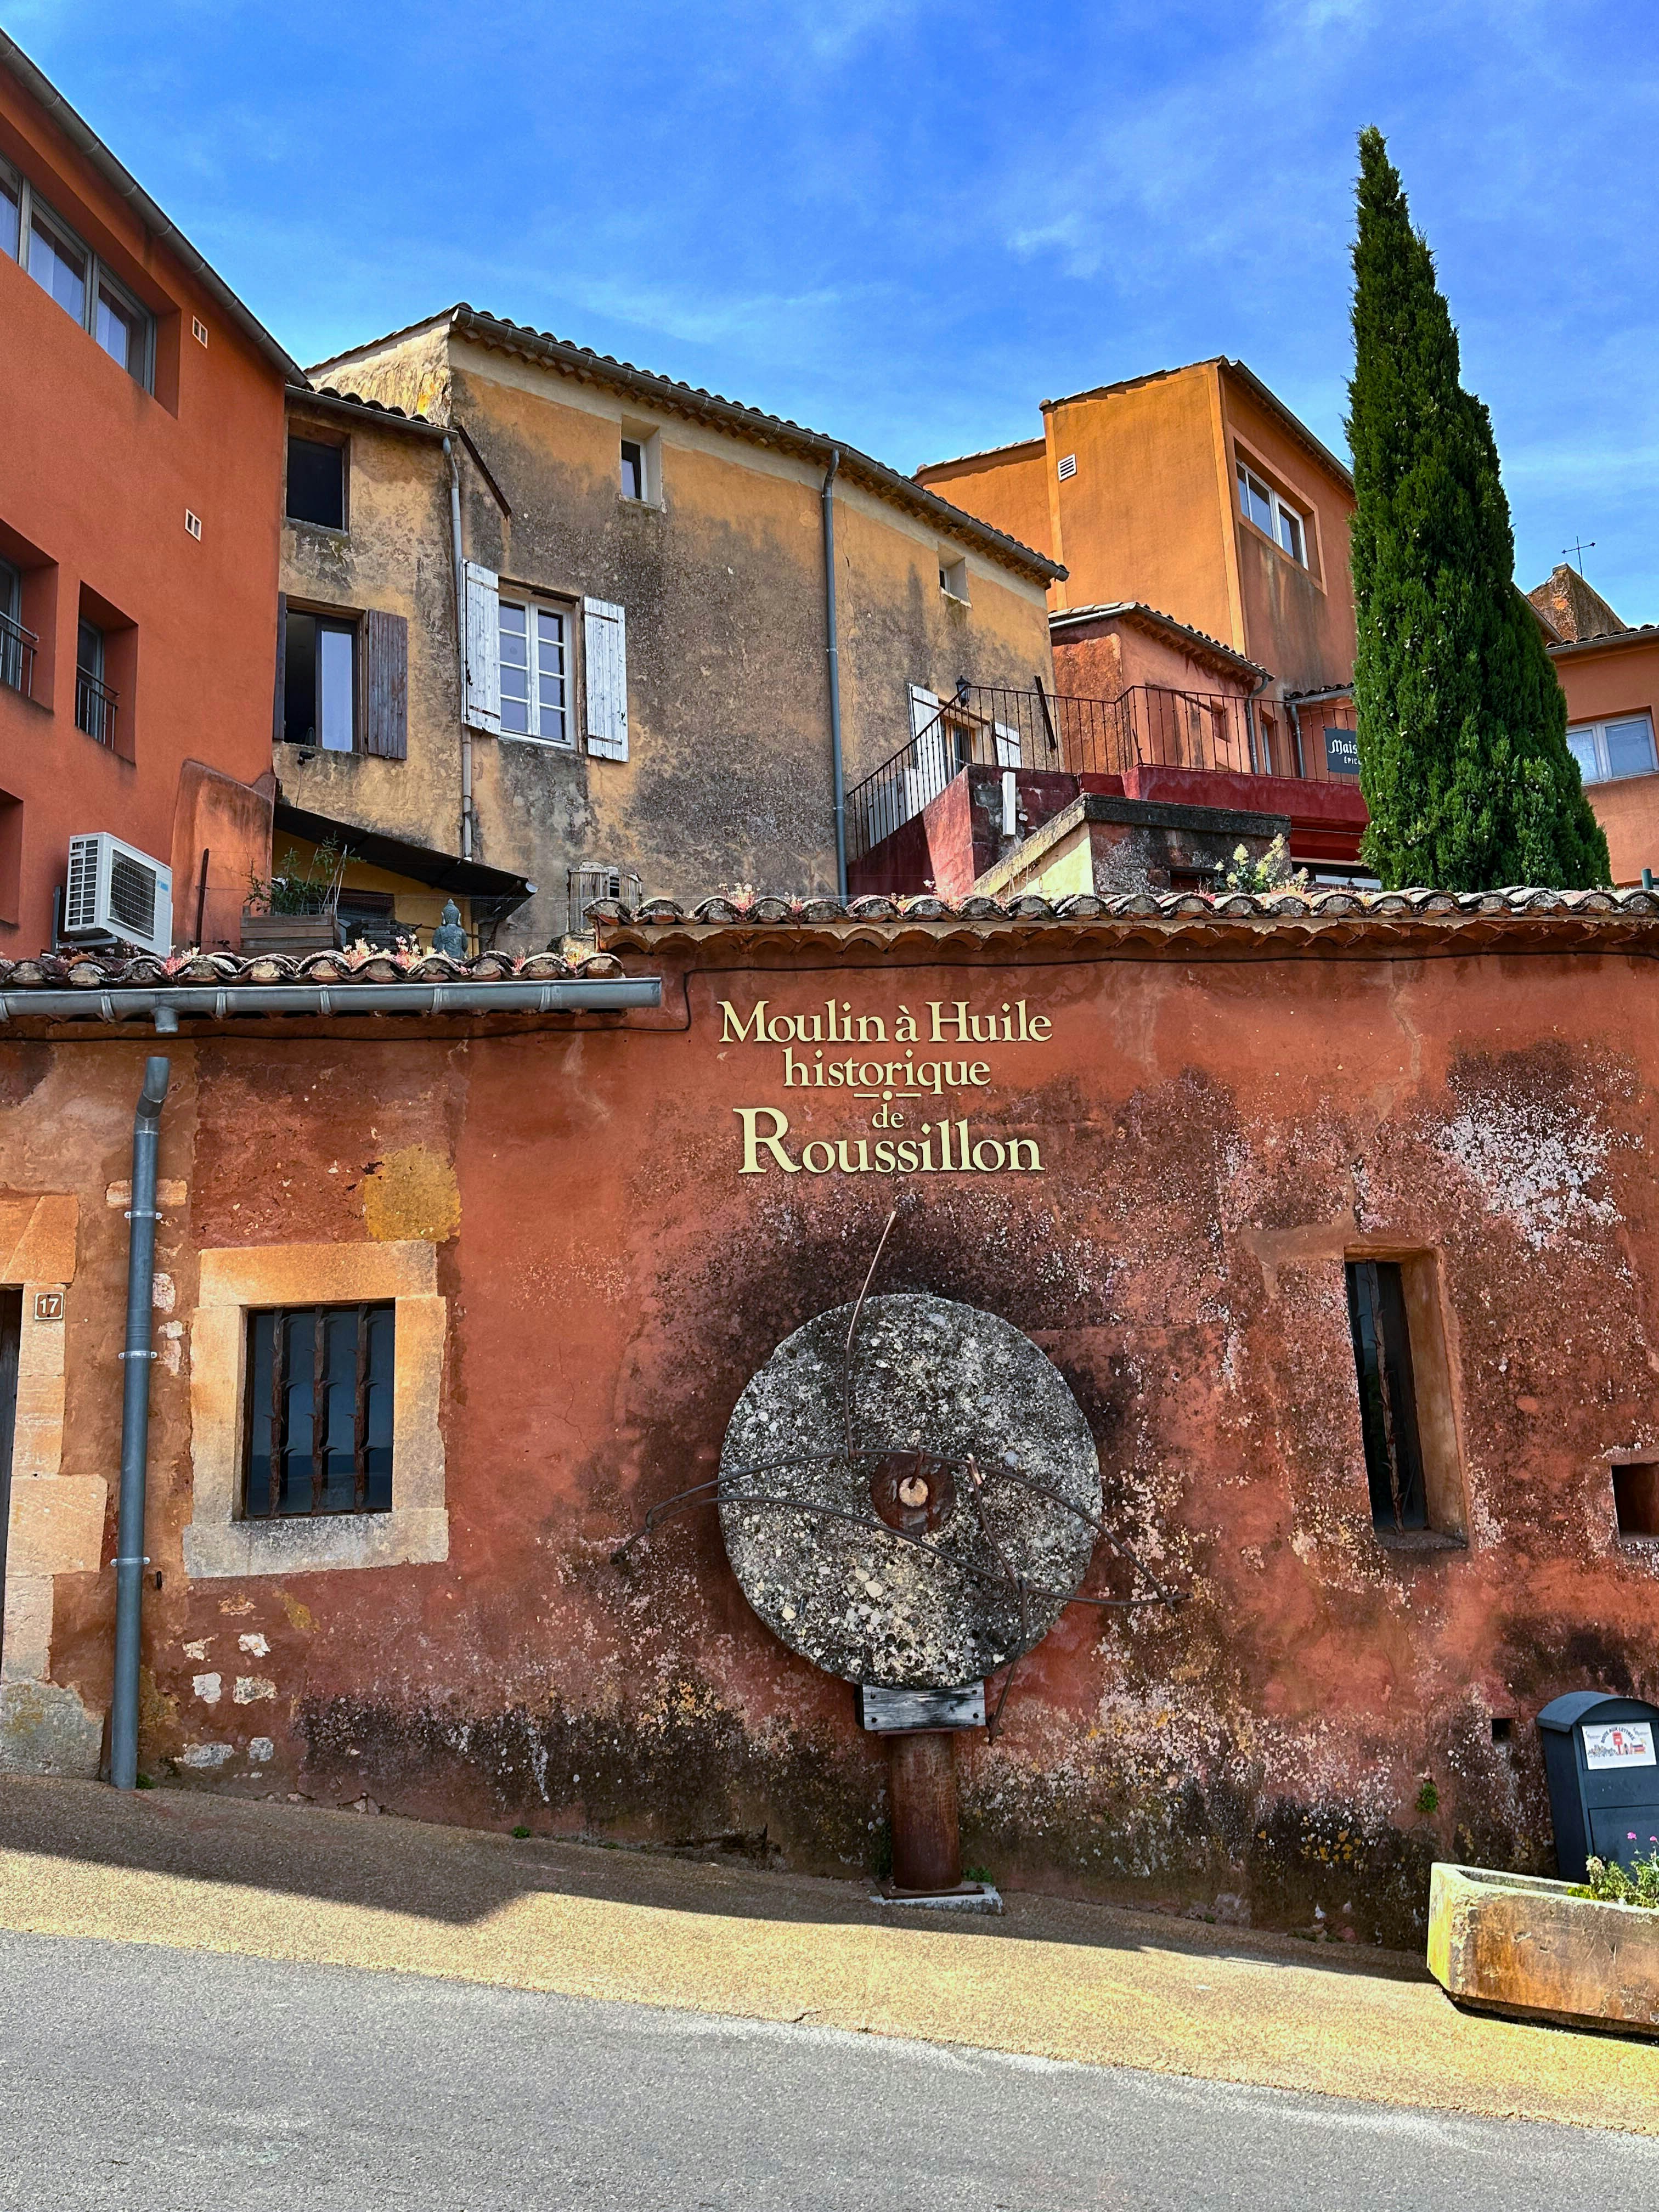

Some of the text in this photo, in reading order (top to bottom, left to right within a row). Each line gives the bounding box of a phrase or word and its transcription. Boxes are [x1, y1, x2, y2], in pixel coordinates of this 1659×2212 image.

[717, 998, 1053, 1042] Moulin à Huile
[782, 1046, 991, 1094] historique
[872, 1103, 904, 1129] de
[732, 1107, 1045, 1174] Roussillon
[40, 1298, 59, 1314] 17
